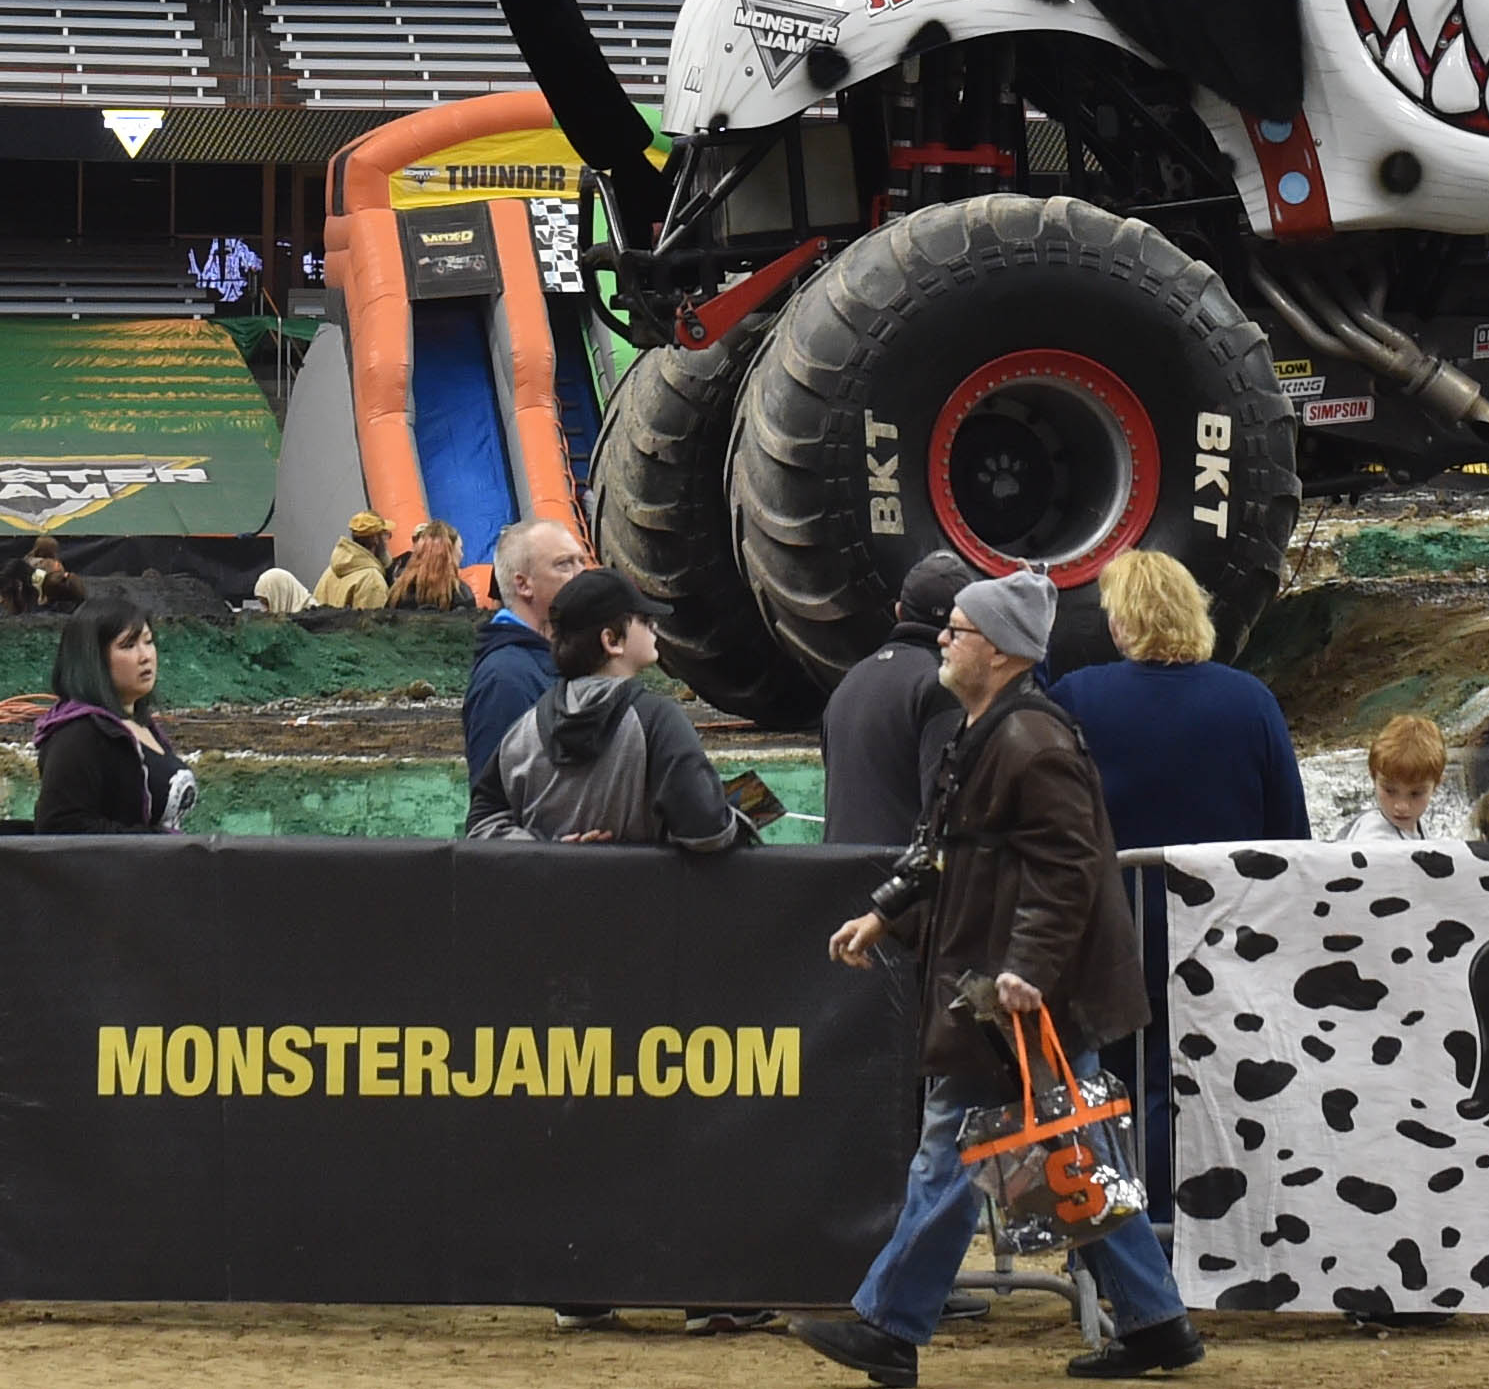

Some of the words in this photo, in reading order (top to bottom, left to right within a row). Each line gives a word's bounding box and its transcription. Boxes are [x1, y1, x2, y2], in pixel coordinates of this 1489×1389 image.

[734, 7, 840, 44] MONSTER
[756, 31, 809, 55] JAM
[445, 165, 567, 191] THUNDER
[537, 228, 577, 245] VS
[1308, 401, 1369, 421] SIMPSON
[864, 409, 905, 535] BKT
[1193, 411, 1232, 539] BKT
[97, 1025, 801, 1097] MONSTERJAM.COM
[1045, 1144, 1108, 1224] S
